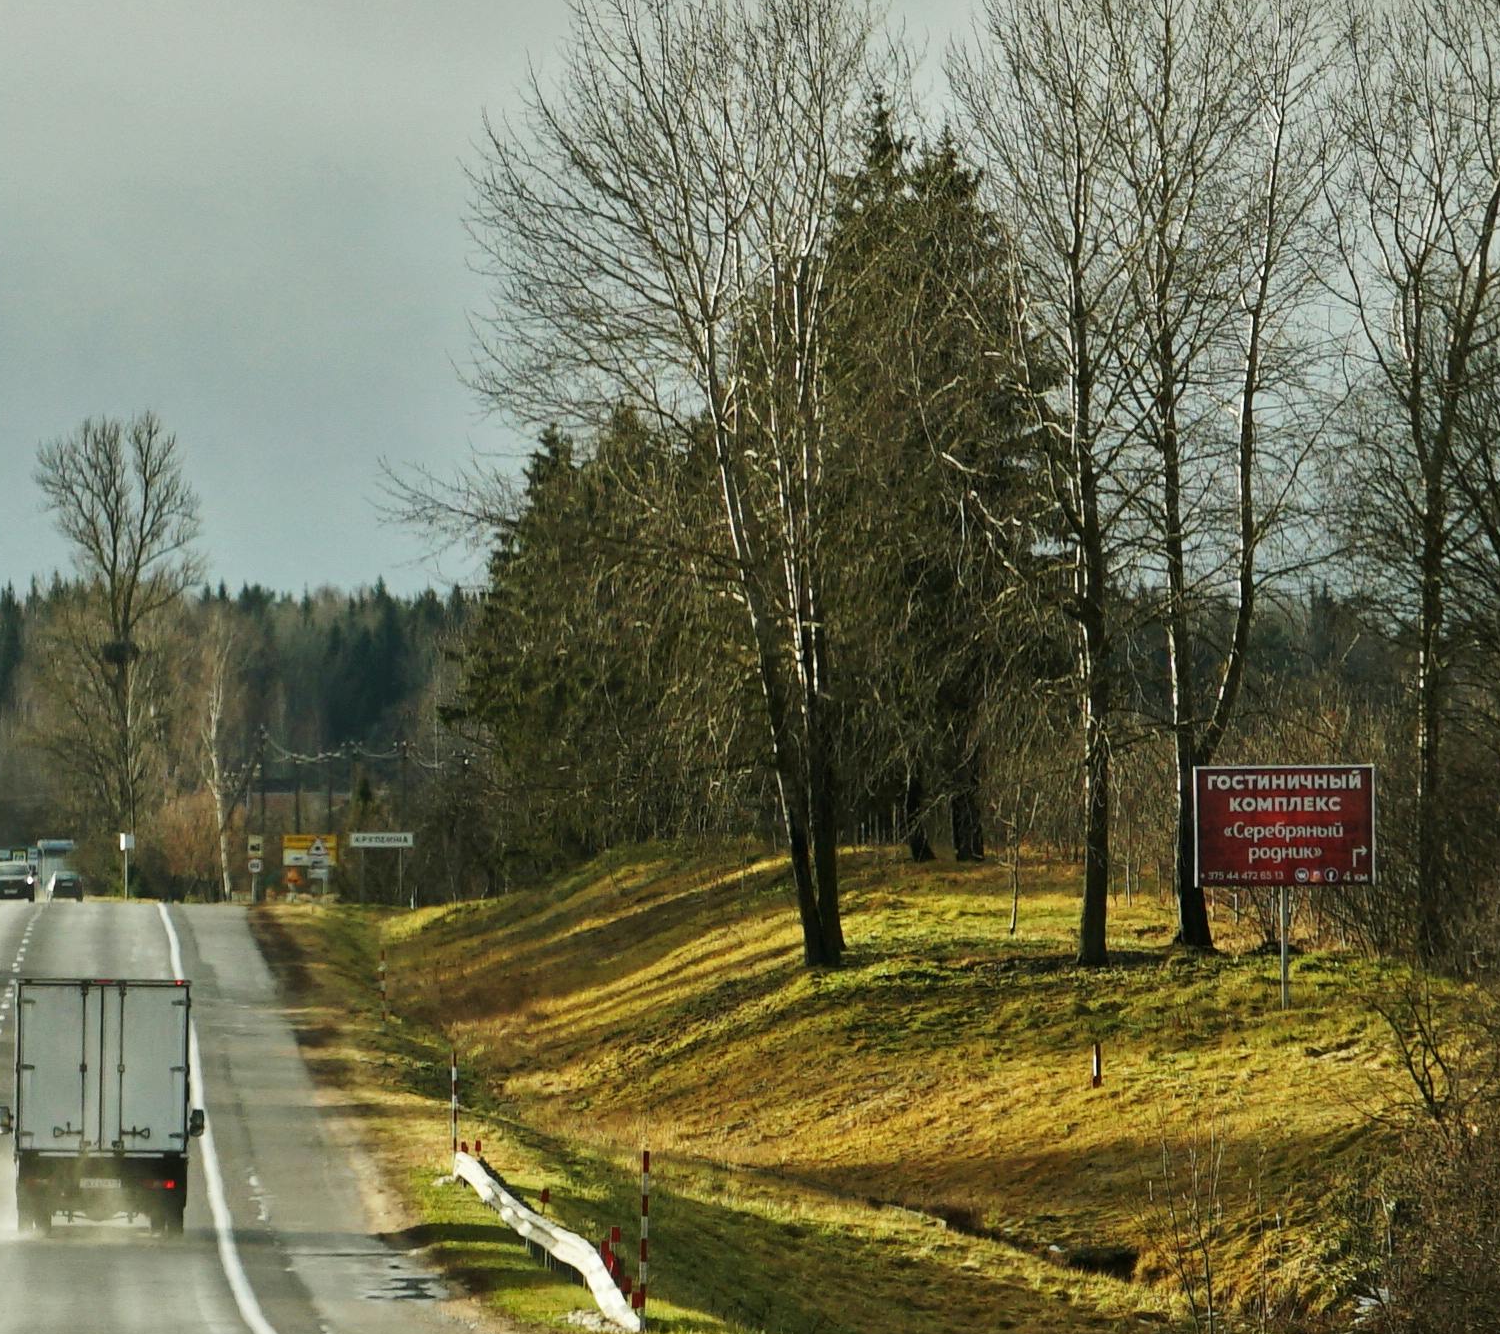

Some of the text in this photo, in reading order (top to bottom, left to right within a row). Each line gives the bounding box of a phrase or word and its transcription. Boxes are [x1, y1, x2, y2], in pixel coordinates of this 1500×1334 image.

[1207, 770, 1362, 790] ГОСТИНИЧНЫЙ
[1229, 796, 1342, 812] КОМПЛЕКС
[1224, 821, 1344, 843] «Серебряный
[1248, 846, 1322, 864] родник»
[1208, 871, 1224, 880] 375
[1226, 871, 1240, 880] 44
[1241, 871, 1258, 880] 472
[1342, 871, 1369, 882] 4 км
